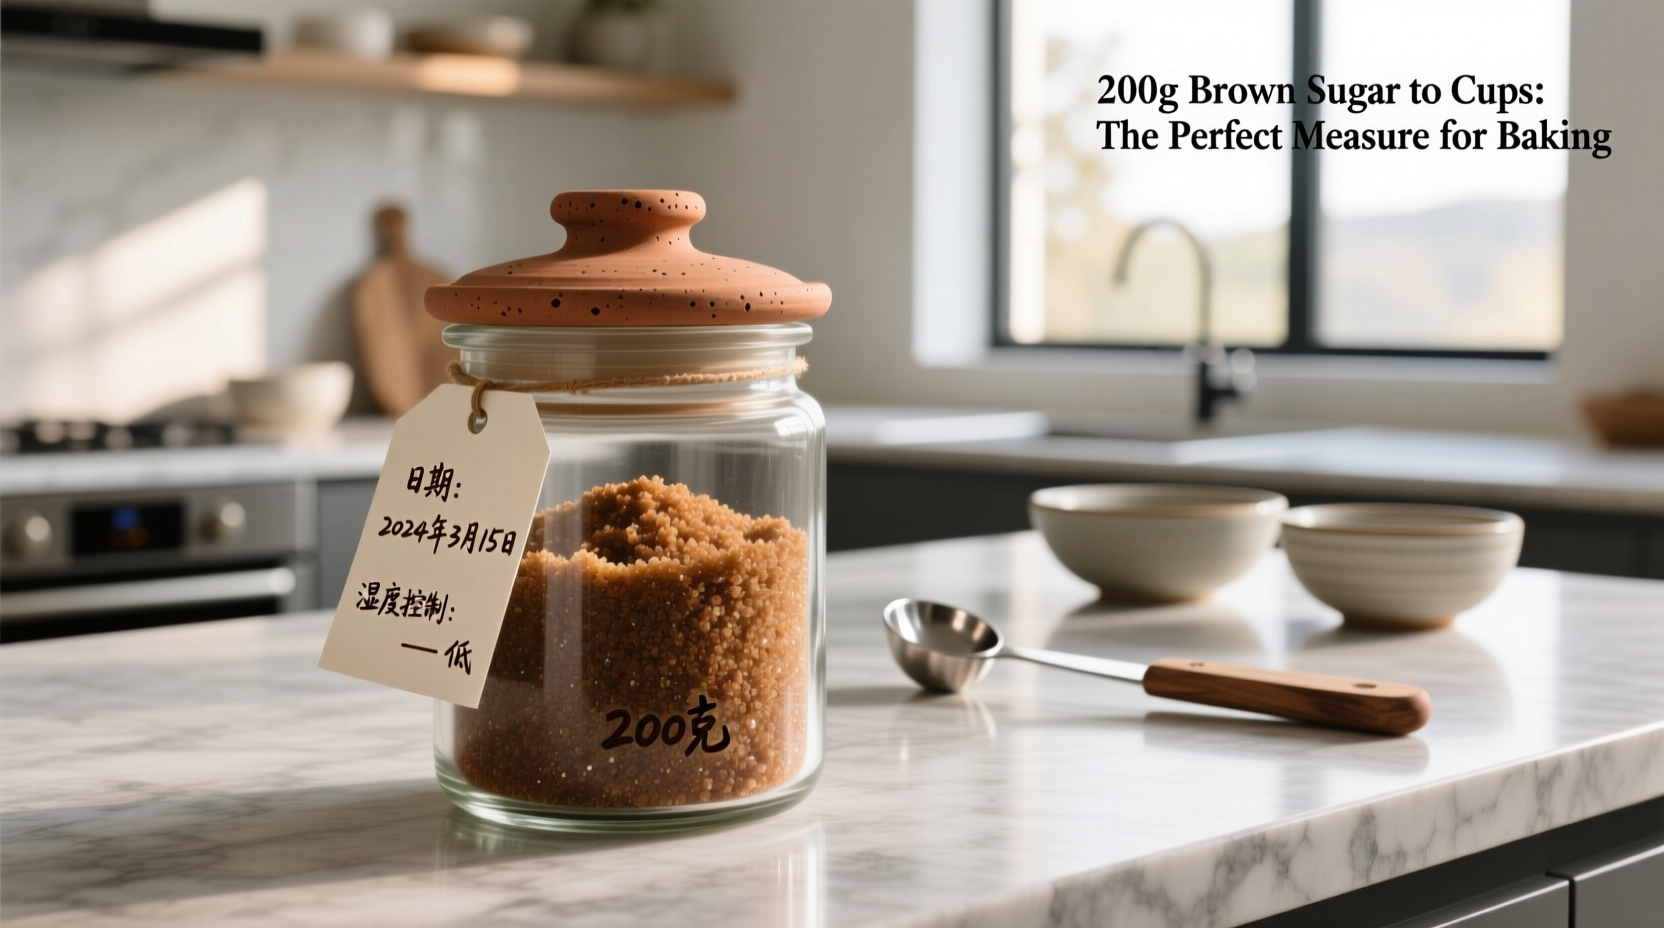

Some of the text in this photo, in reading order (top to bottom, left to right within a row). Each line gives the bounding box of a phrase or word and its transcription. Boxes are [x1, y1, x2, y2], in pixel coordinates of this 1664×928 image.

[407, 462, 461, 502] 日期:
[378, 514, 516, 556] 2024年3月15日
[356, 582, 454, 625] 湿度控制:
[602, 695, 730, 756] 200克
